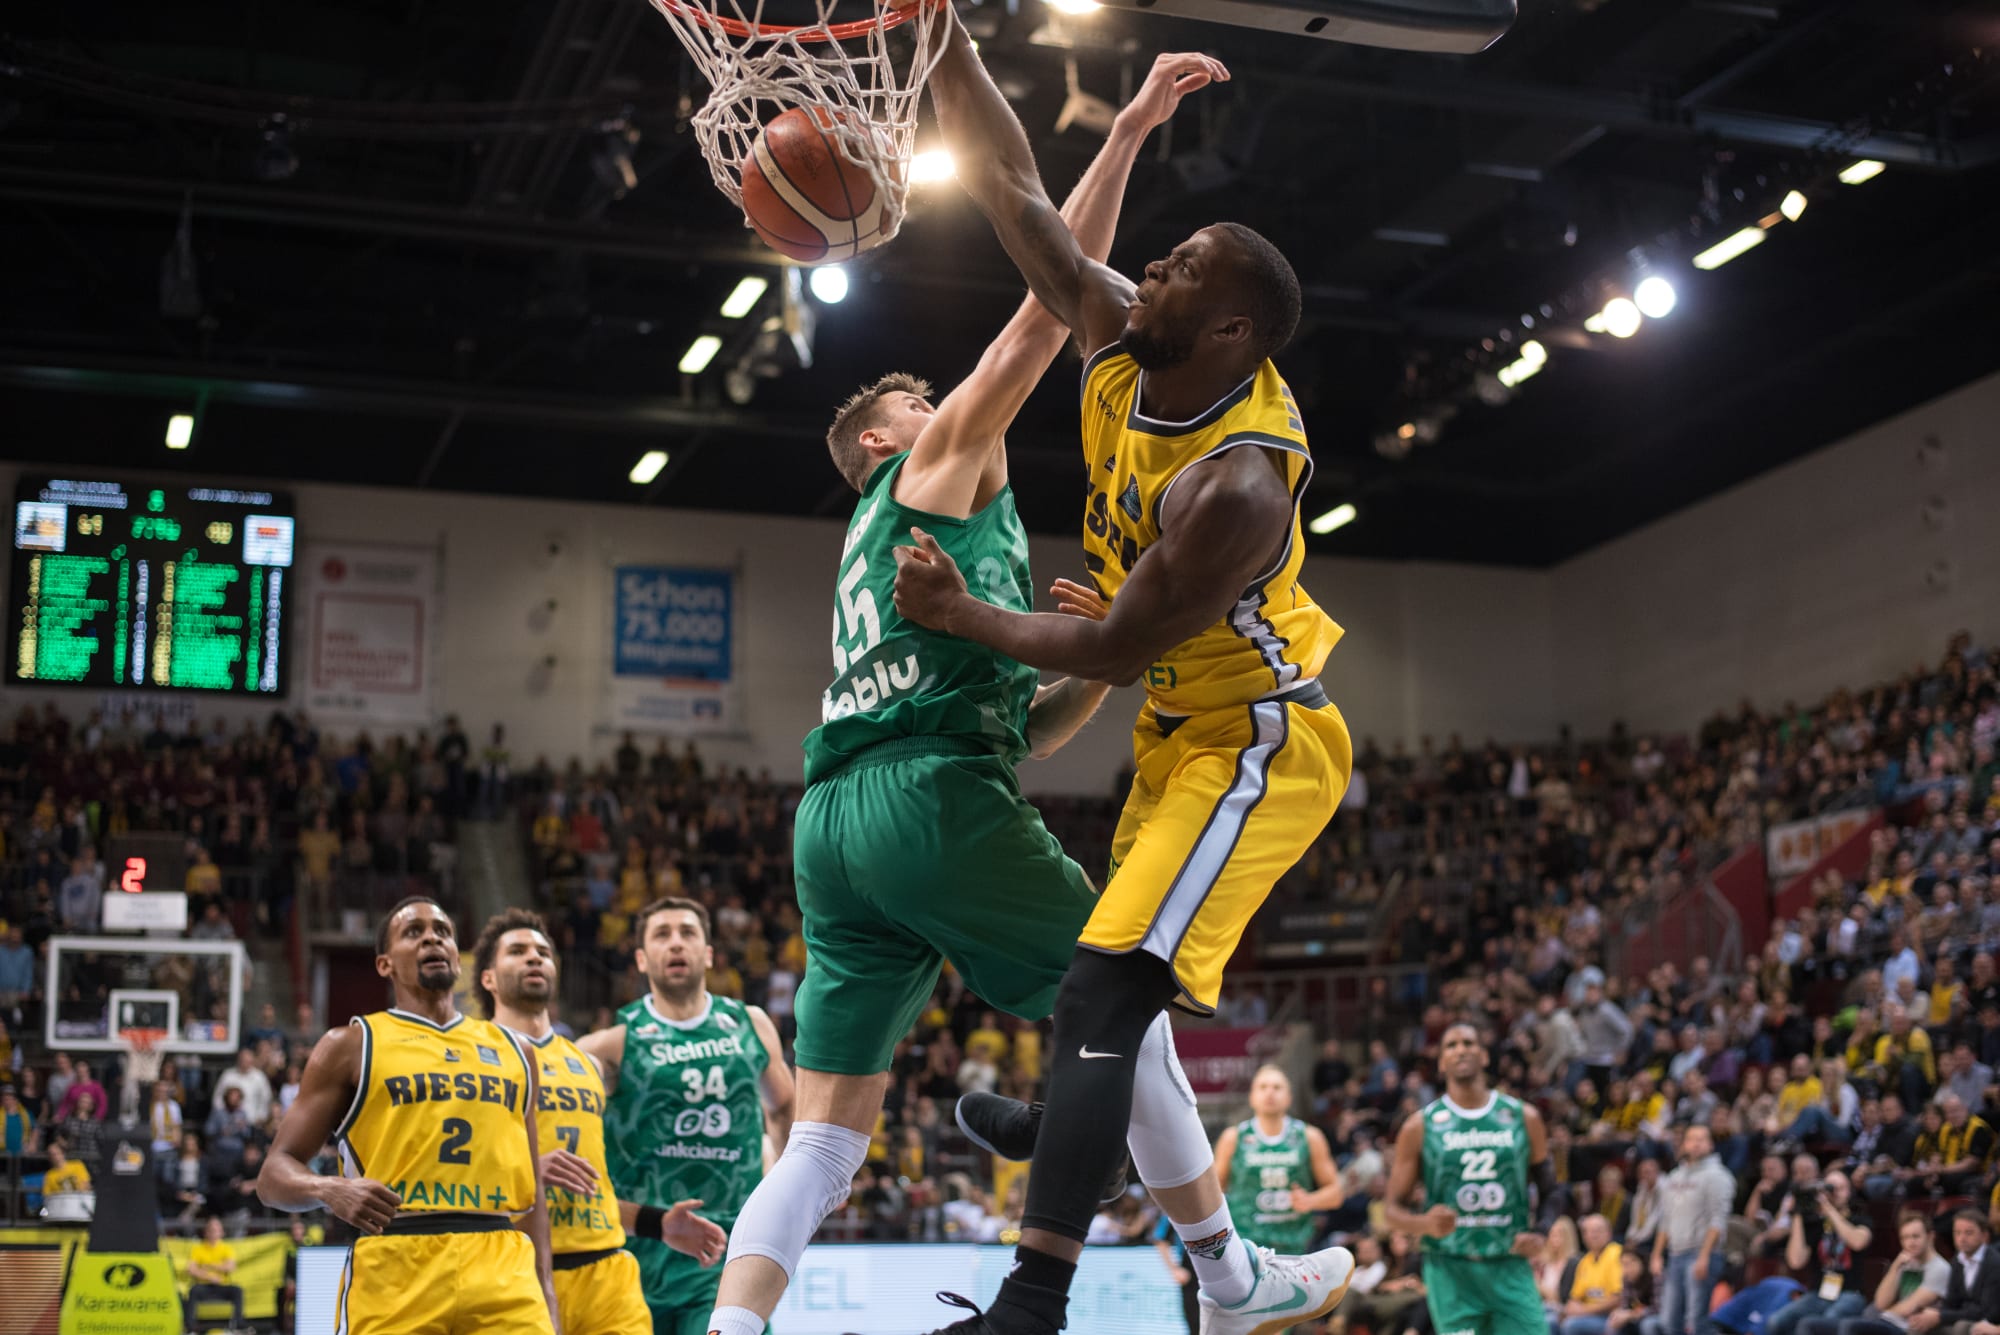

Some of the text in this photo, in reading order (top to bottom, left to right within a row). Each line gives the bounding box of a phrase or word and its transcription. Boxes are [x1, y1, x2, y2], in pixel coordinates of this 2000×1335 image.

[622, 573, 725, 609] Schon
[623, 611, 724, 643] 75.000
[121, 857, 147, 893] 2
[650, 1034, 746, 1066] Stelmet
[384, 1072, 520, 1113] RIESEN
[681, 1065, 727, 1104] 34
[437, 1117, 473, 1166] 2
[556, 1126, 581, 1157] 7
[1443, 1127, 1515, 1151] Stelmet
[1459, 1149, 1498, 1181] 22
